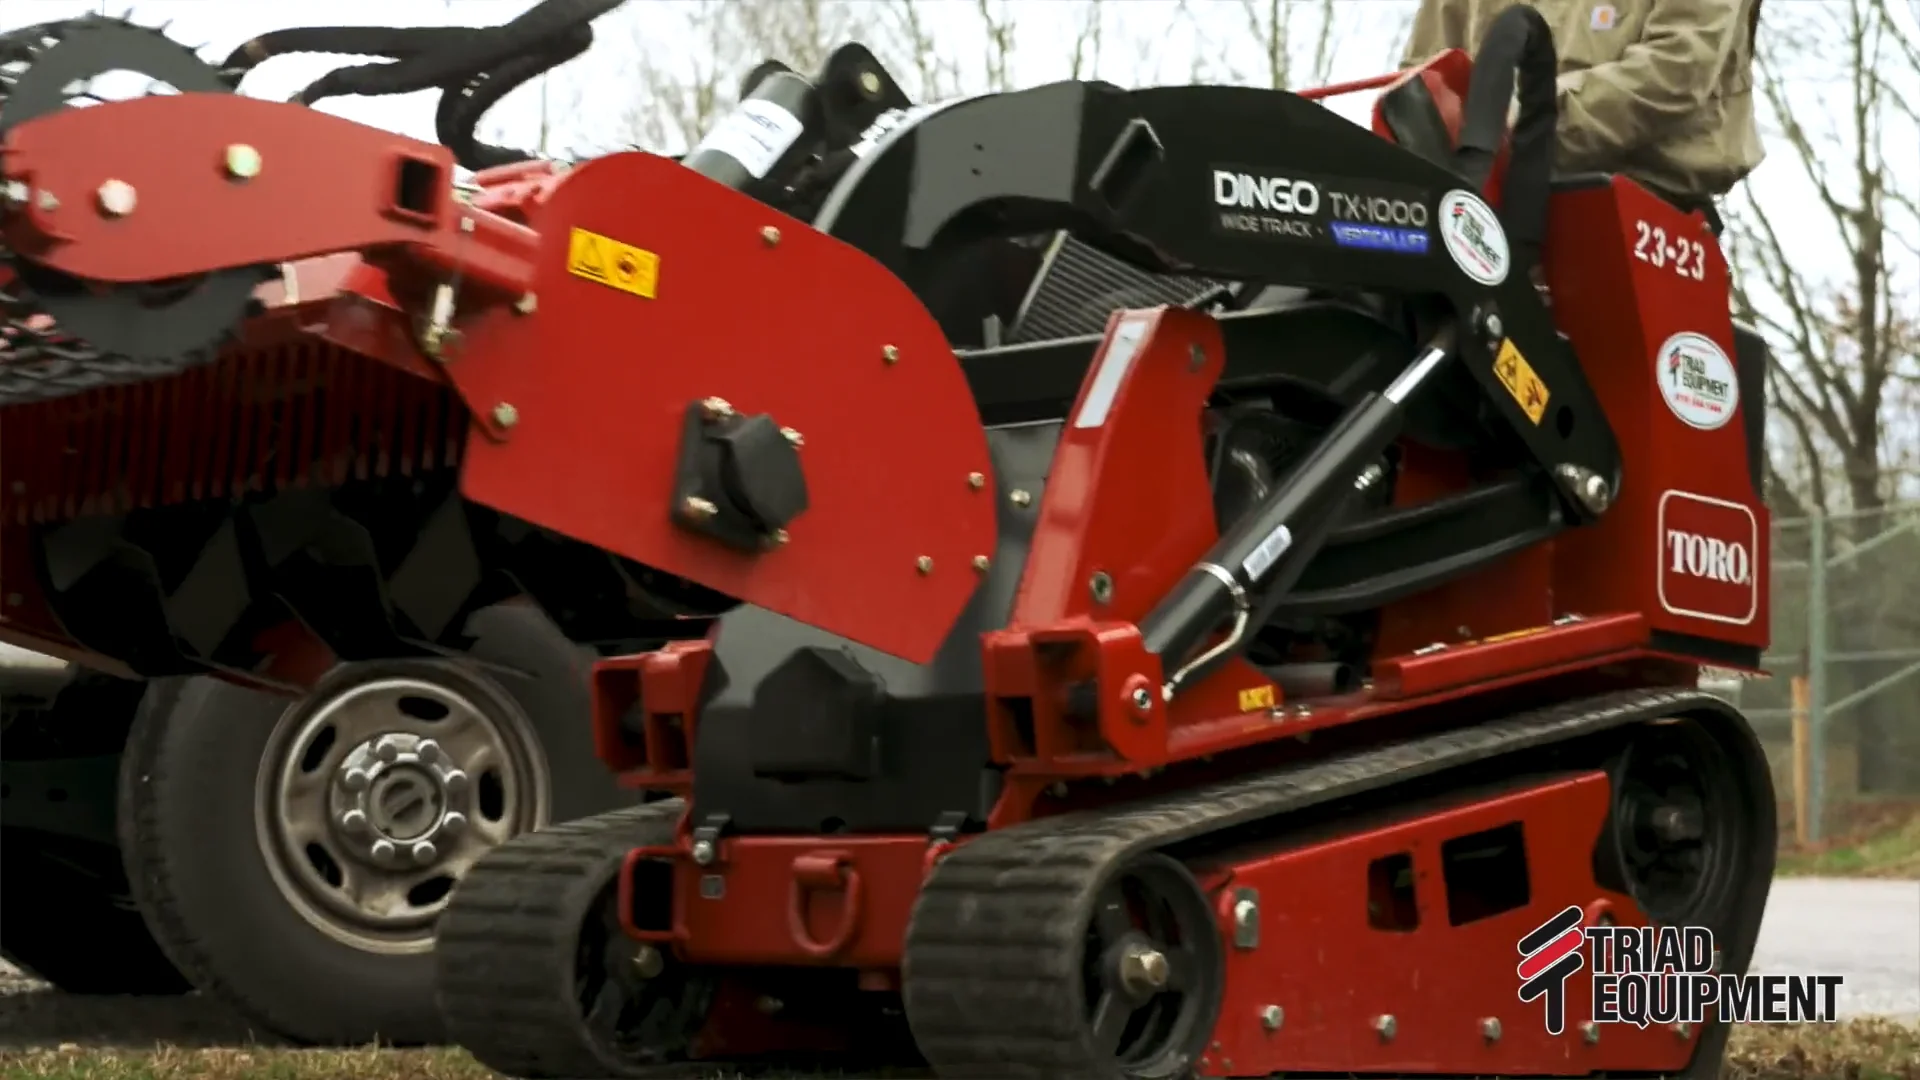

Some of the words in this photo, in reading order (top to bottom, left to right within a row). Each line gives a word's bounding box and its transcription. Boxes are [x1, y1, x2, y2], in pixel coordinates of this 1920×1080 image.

[1213, 169, 1320, 215] DINGO
[1220, 213, 1260, 233] WIDE
[1260, 216, 1313, 238] TRACK
[1634, 220, 1705, 281] 23-23
[1681, 354, 1706, 376] TRIAD
[1682, 371, 1729, 398] EQUIPMENT
[1667, 529, 1749, 585] TORO
